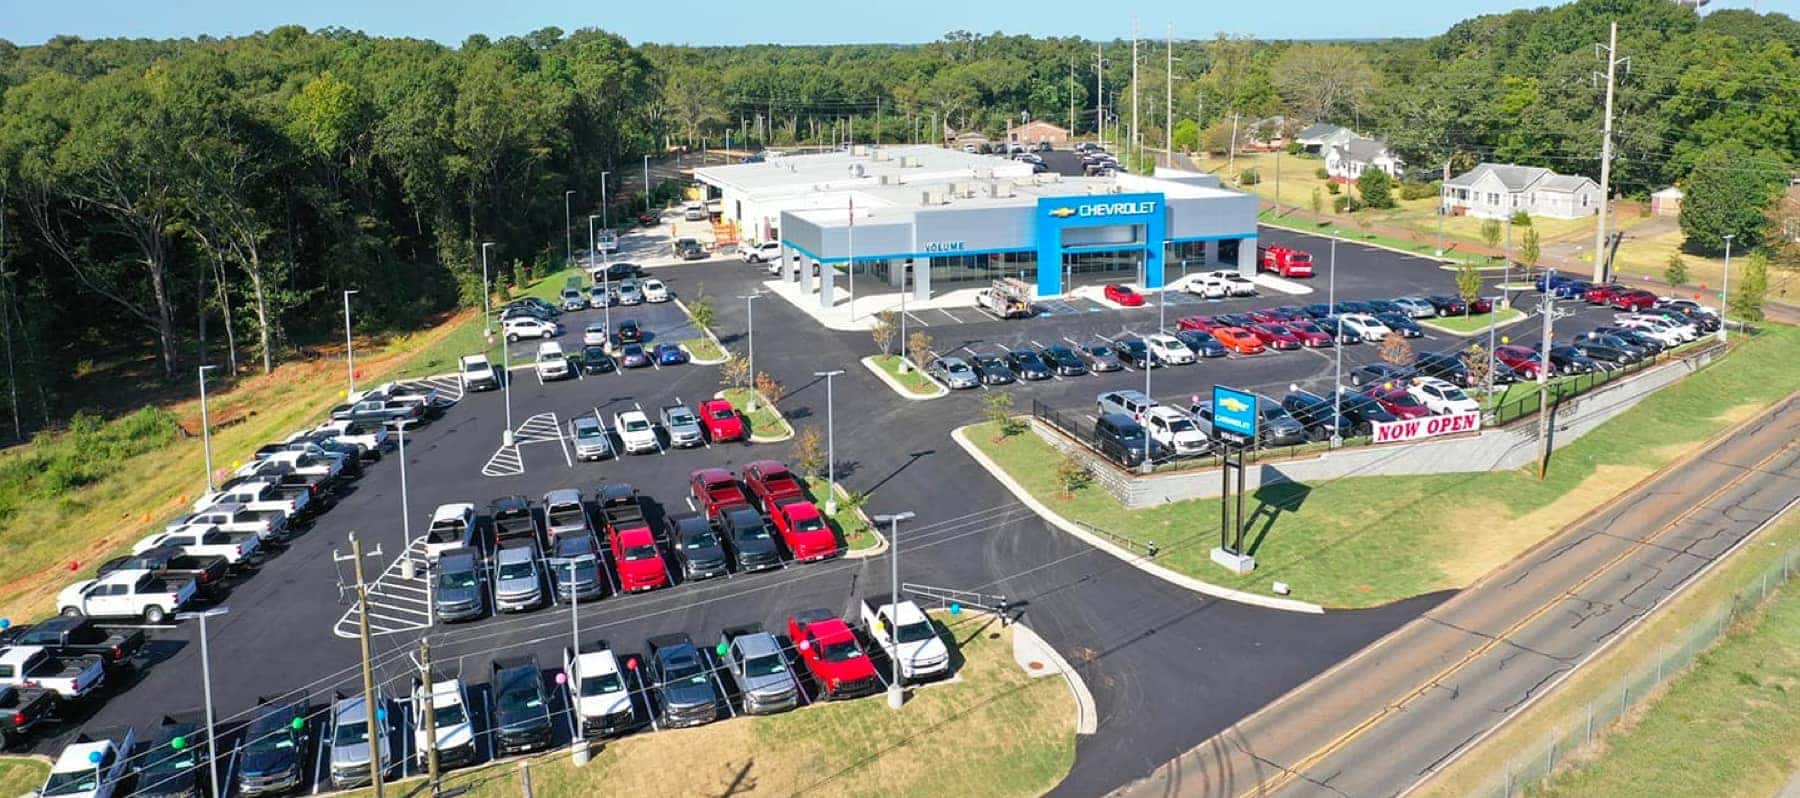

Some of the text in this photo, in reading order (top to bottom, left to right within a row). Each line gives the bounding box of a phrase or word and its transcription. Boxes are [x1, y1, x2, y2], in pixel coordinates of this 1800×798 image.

[1079, 202, 1156, 217] CHEVROLET
[1377, 414, 1476, 441] NOW OPEN
